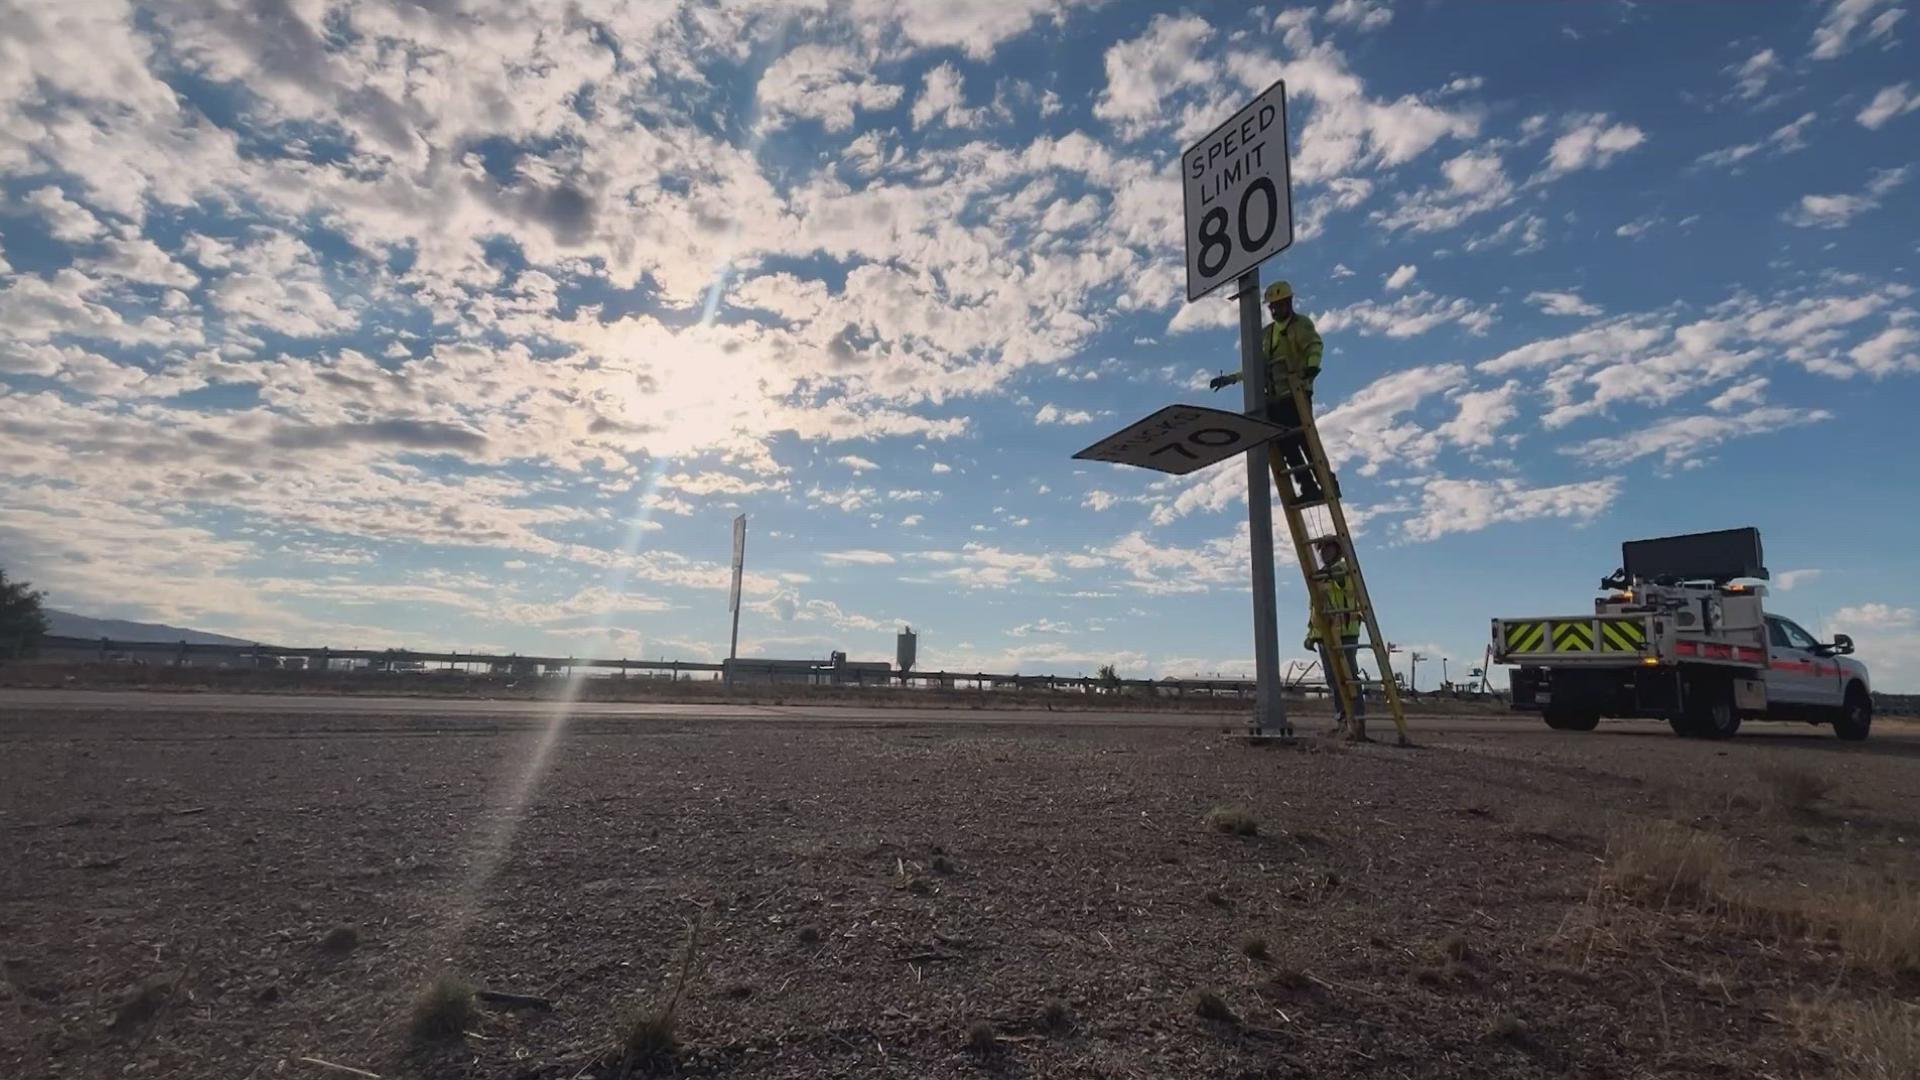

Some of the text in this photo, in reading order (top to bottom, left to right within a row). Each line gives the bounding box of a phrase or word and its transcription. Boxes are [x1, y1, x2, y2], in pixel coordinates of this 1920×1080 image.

[1192, 105, 1275, 180] SPEED
[1201, 142, 1266, 206] LIMIT
[1197, 176, 1278, 278] 80
[1149, 428, 1241, 459] 70
